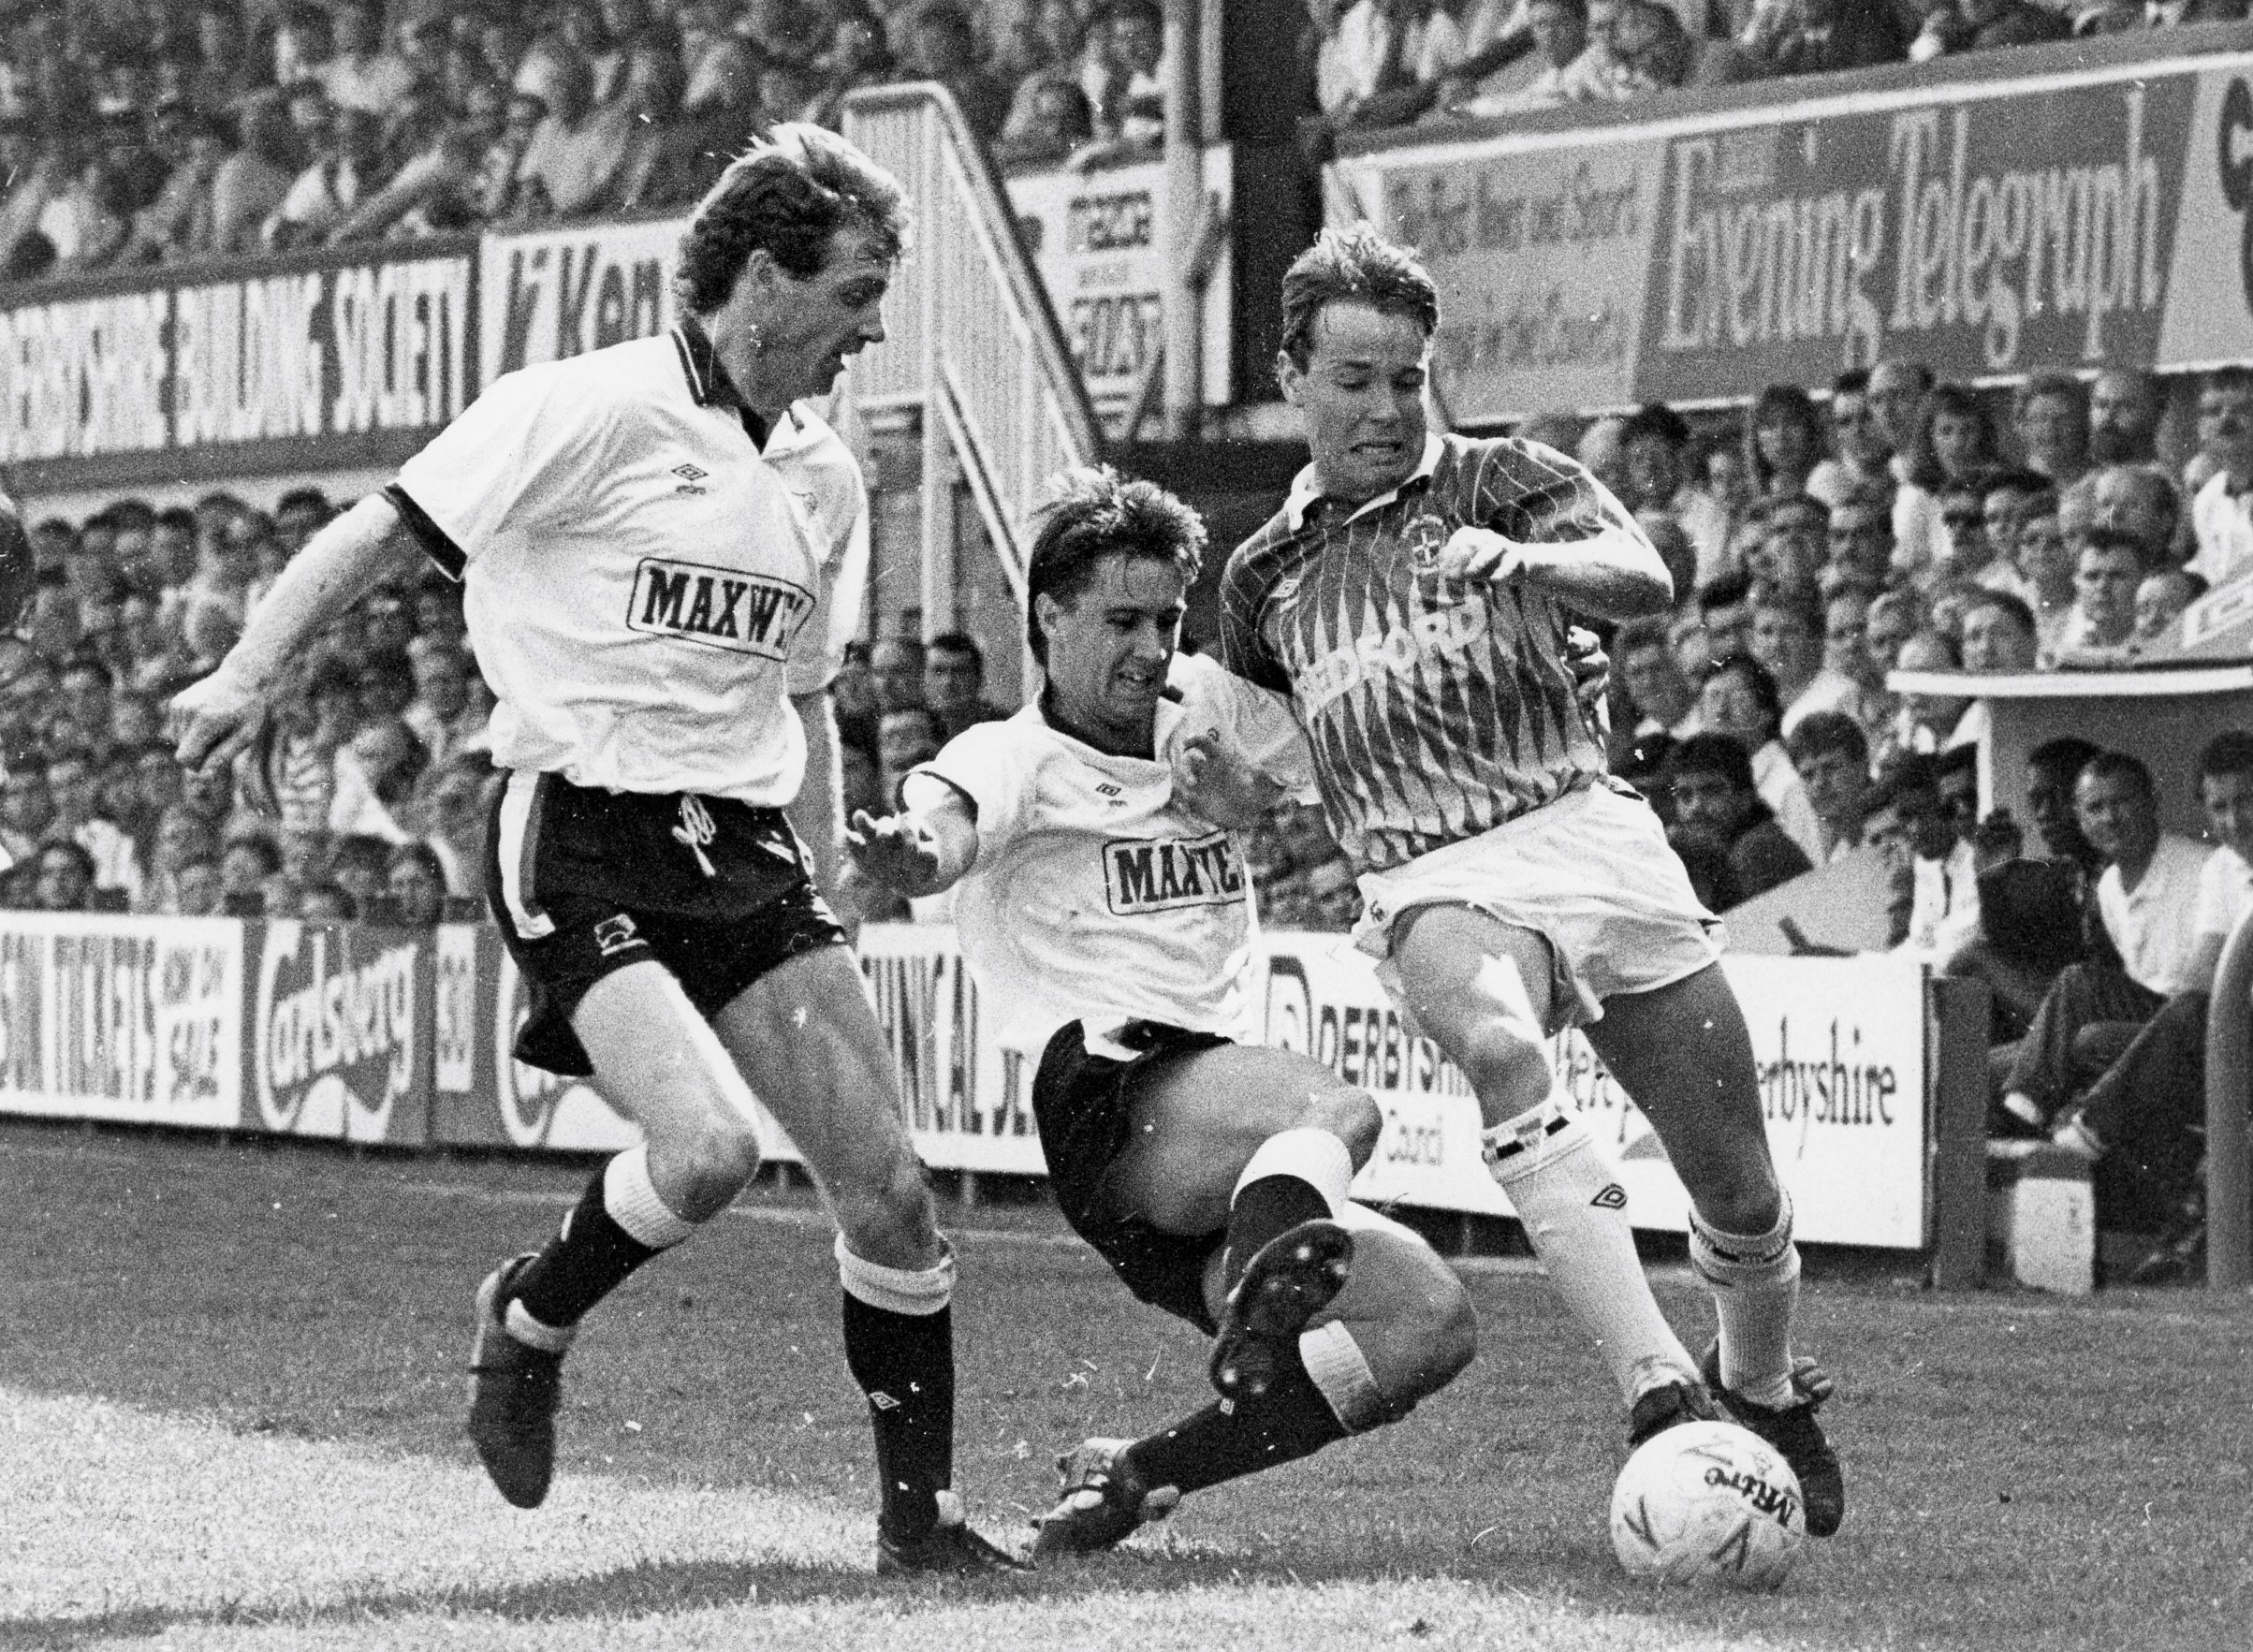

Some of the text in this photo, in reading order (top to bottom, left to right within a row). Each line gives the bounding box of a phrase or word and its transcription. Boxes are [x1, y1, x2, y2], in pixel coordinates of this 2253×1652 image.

[1660, 126, 1885, 370] Evening
[1887, 88, 2159, 369] Telegraph
[255, 919, 418, 1131] Carlsberg
[1703, 1466, 1796, 1529] Mitre
